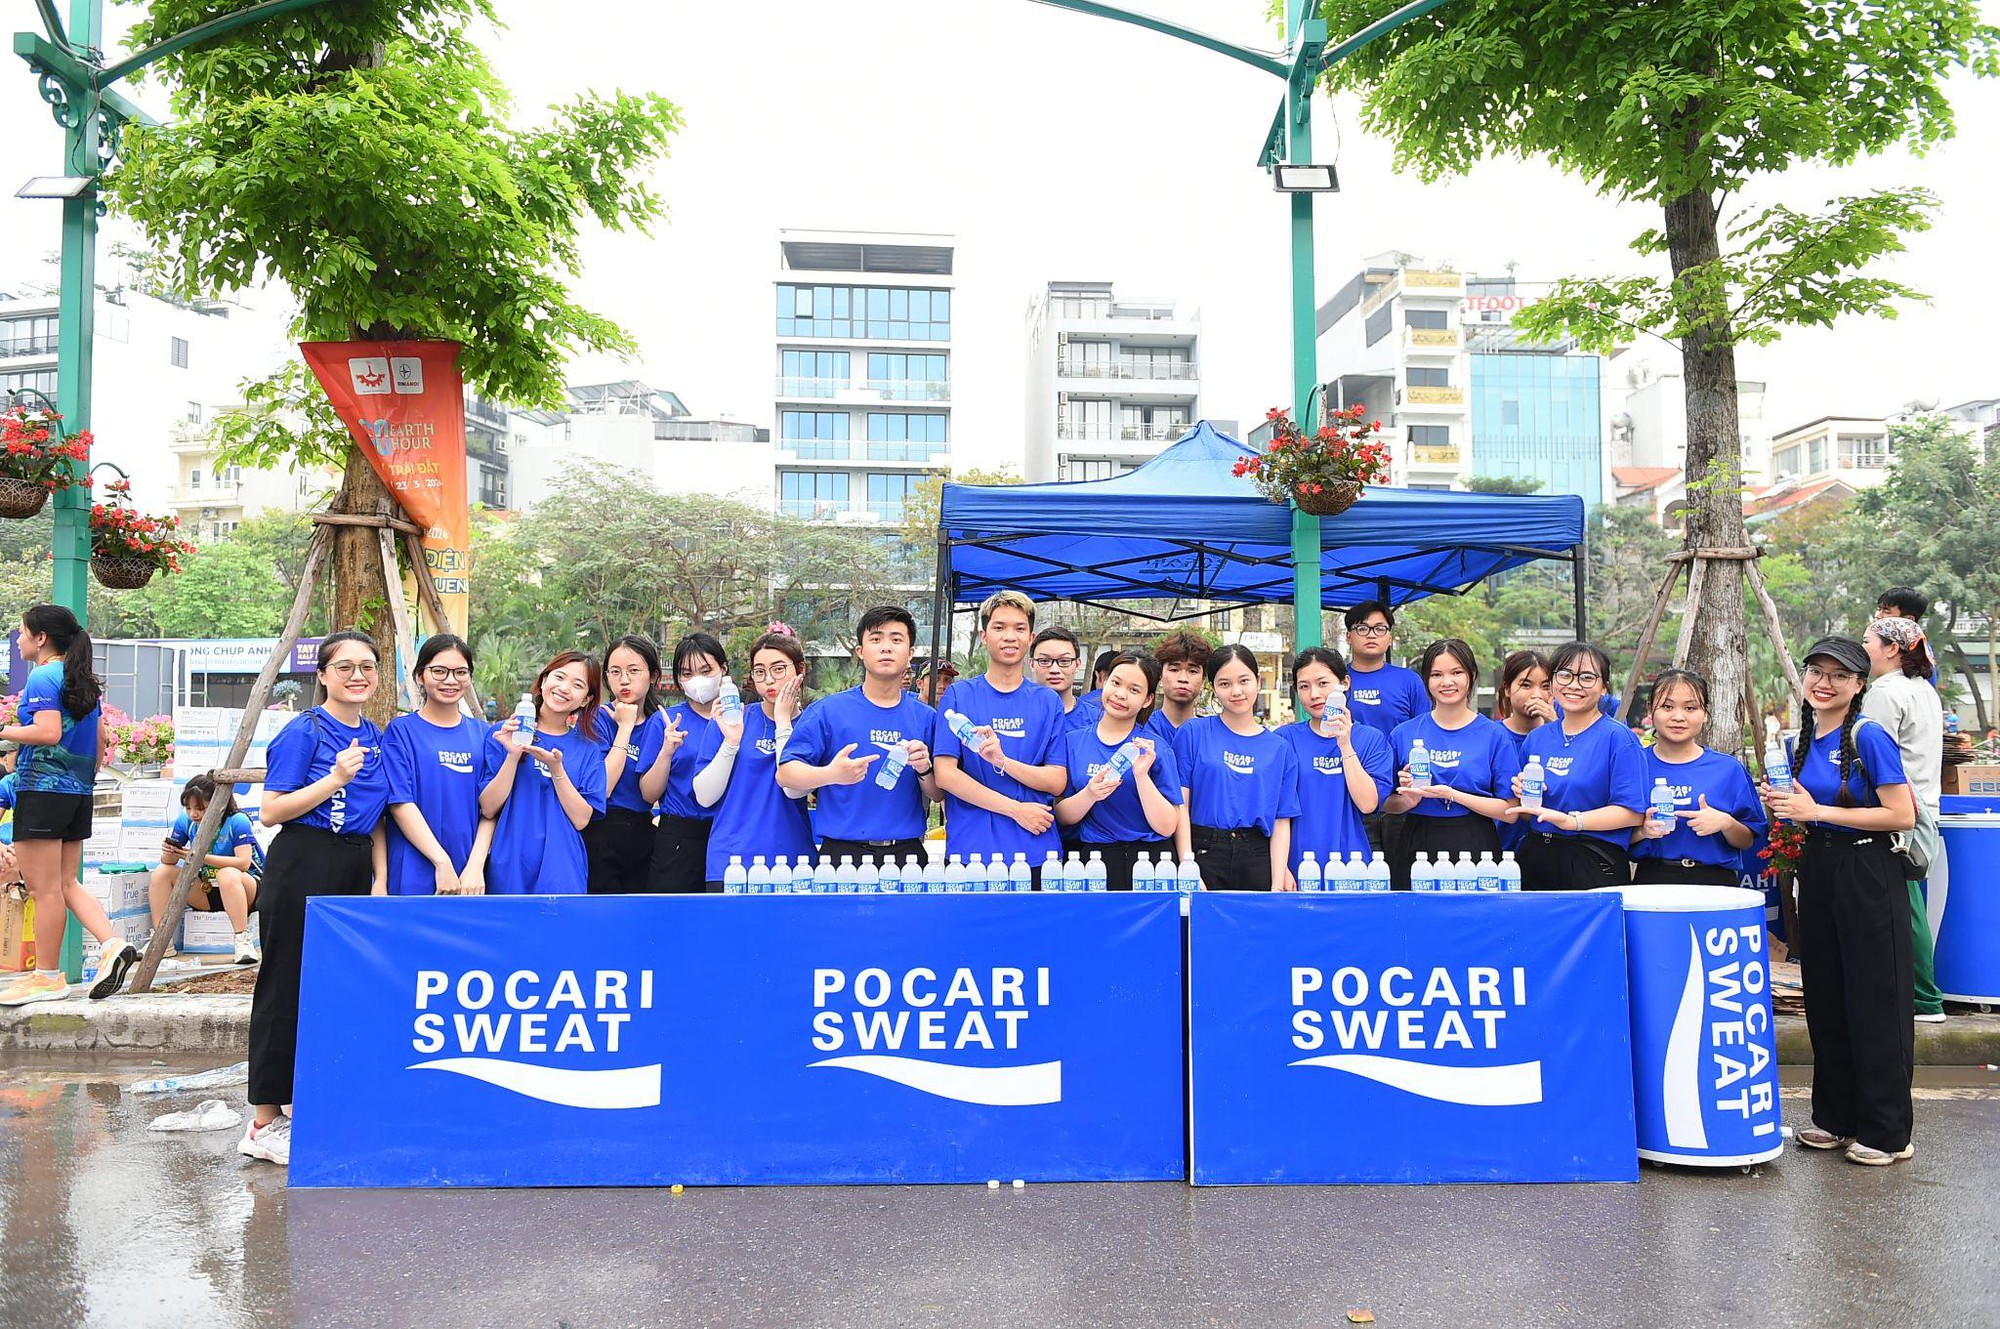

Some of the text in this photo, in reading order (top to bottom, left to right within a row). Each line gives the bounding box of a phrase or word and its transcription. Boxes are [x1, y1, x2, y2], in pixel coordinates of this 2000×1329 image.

[390, 423, 434, 437] EARTH
[391, 437, 432, 450] HOUR
[435, 578, 467, 593] UEN
[416, 970, 652, 1010] POCARI
[813, 968, 1049, 1008] POCARI
[1291, 967, 1525, 1006] POCARI
[413, 1014, 630, 1053] SWEAT
[812, 1011, 1028, 1050] SWEAT
[1292, 1010, 1505, 1049] SWEAT
[1705, 927, 1749, 1119] SWEAT
[1739, 924, 1775, 1137] POCARI
